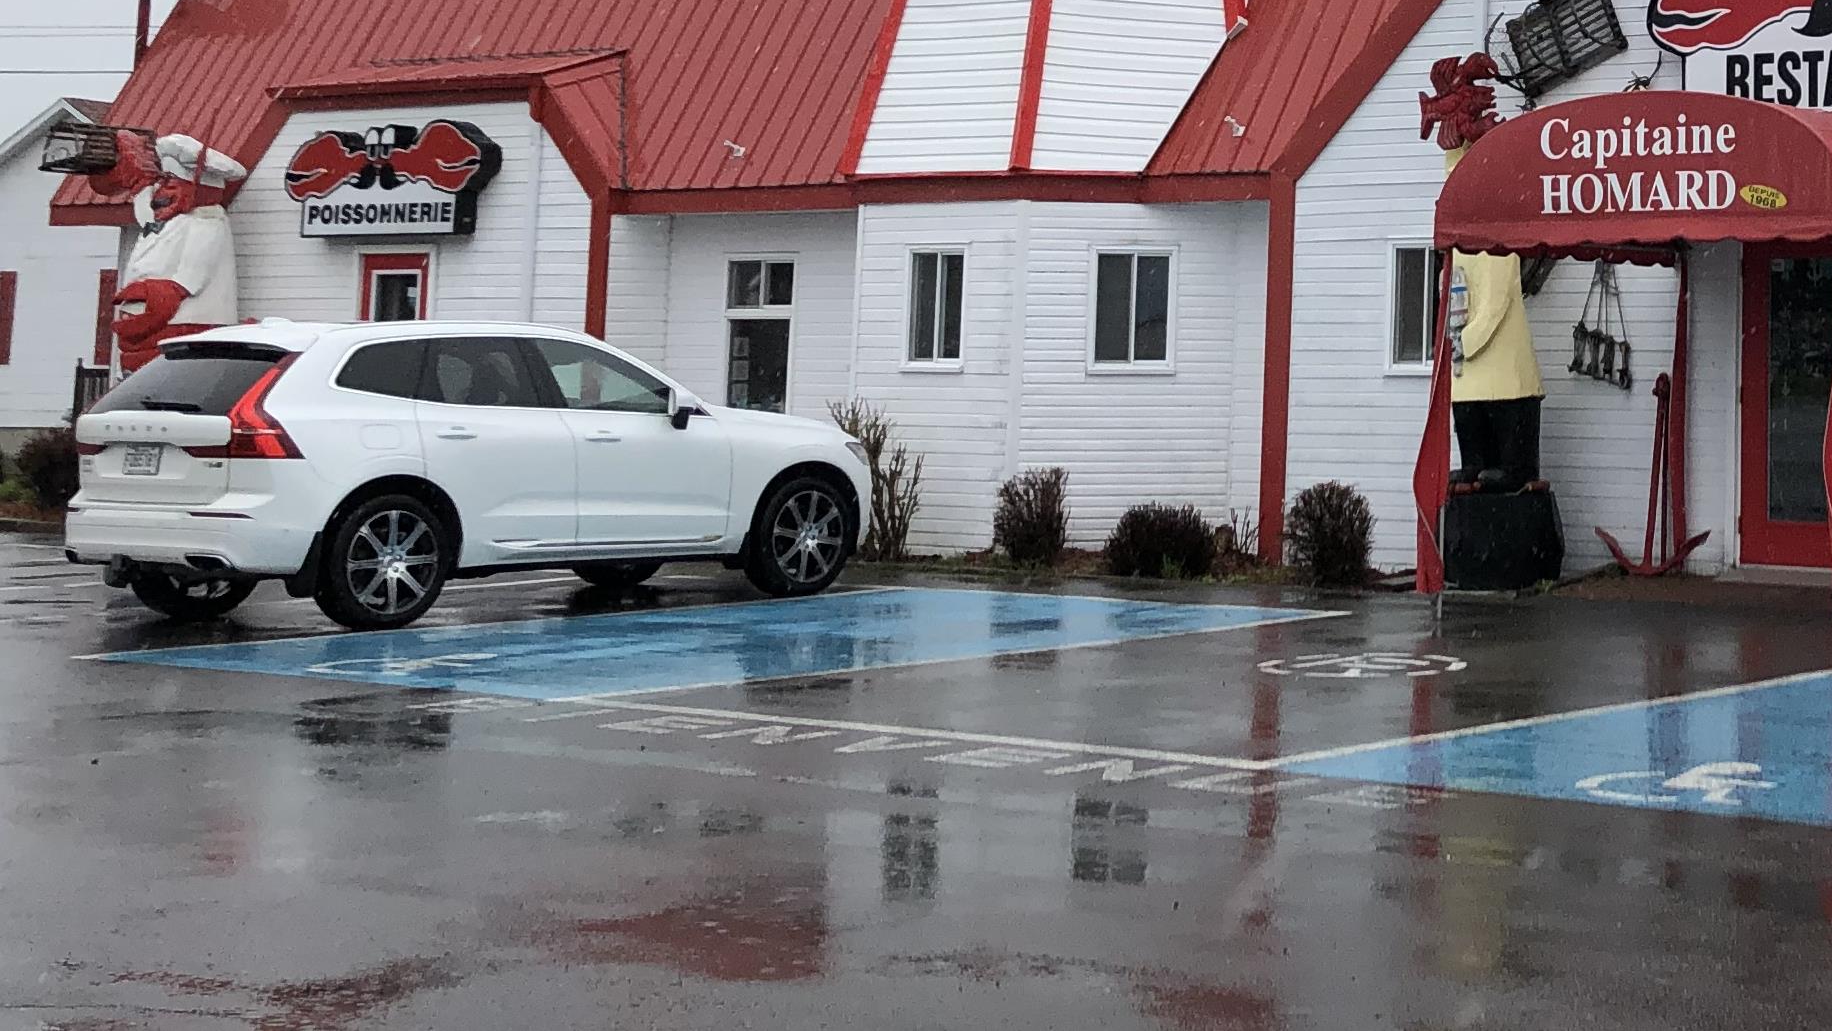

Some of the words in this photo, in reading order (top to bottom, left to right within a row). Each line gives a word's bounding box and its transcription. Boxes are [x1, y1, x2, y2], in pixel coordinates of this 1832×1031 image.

[1540, 113, 1736, 169] Capitaine
[1539, 170, 1736, 215] HOMARD
[1750, 194, 1777, 208] 1968
[307, 202, 452, 225] POISSONNERIE
